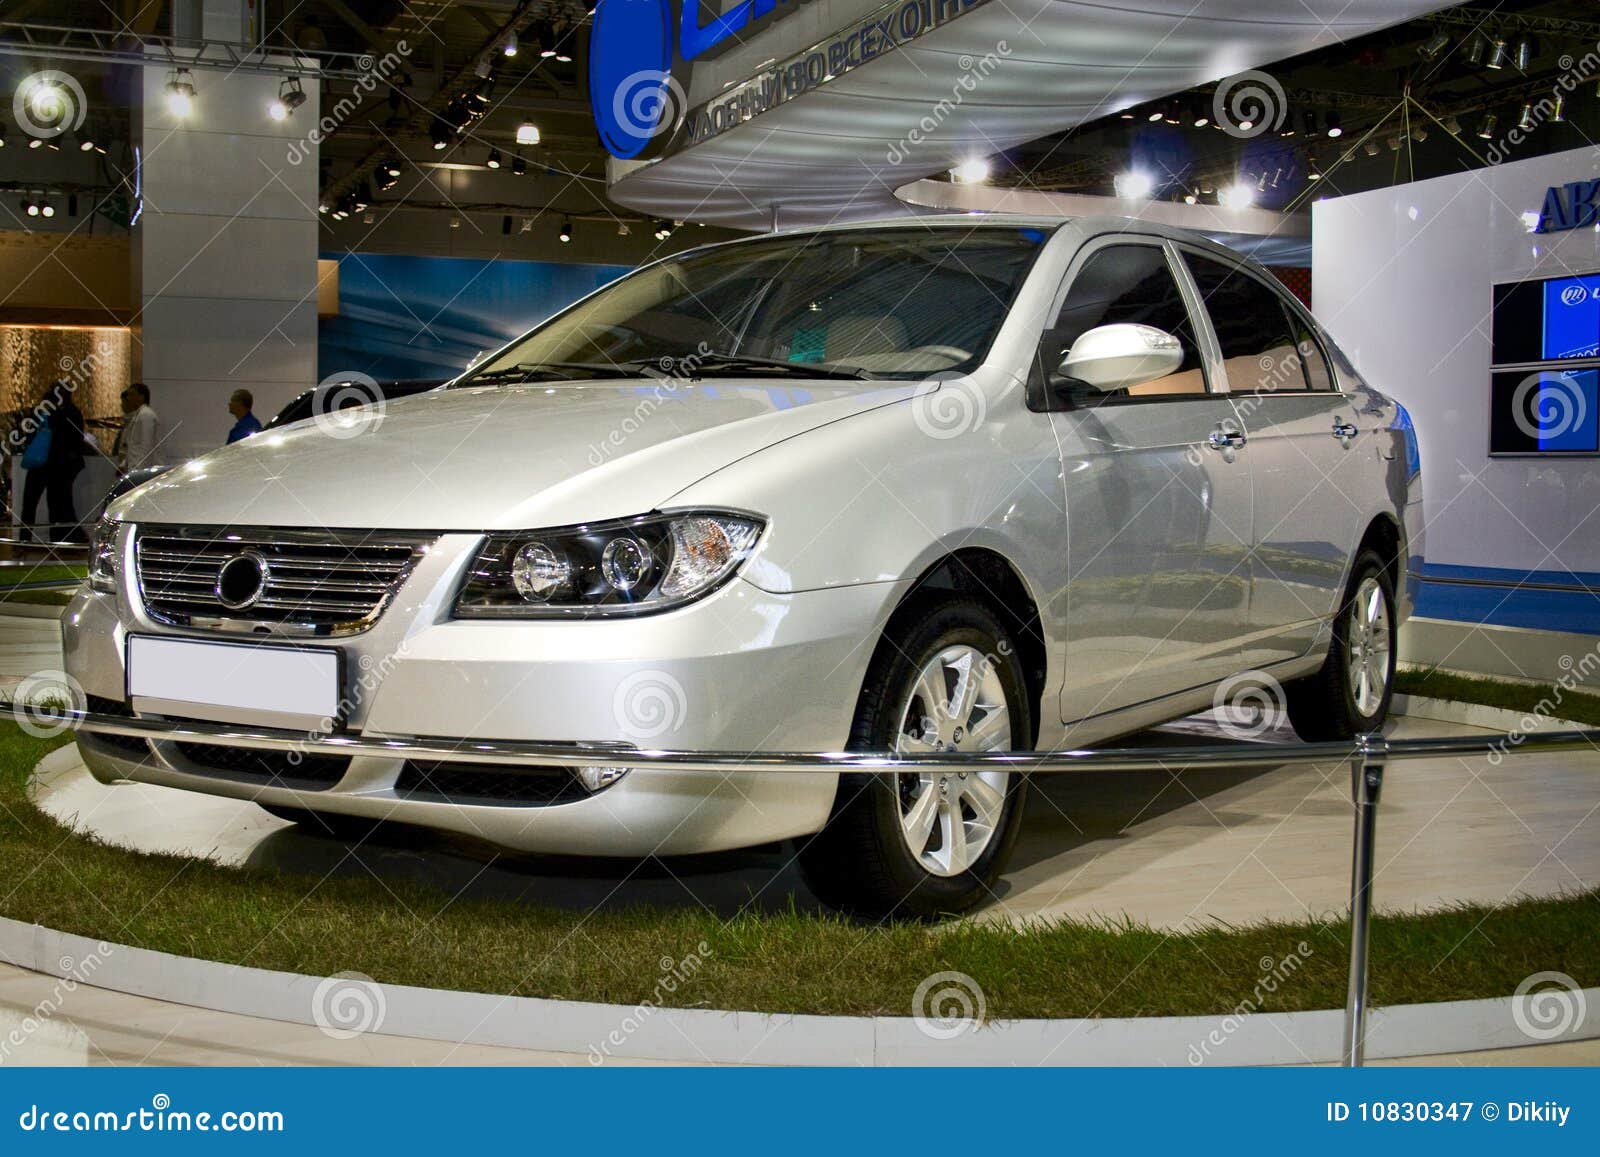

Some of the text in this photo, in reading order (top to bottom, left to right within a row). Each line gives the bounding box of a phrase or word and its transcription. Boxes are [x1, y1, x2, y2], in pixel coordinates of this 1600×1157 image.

[785, 52, 826, 97] ВО
[827, 11, 898, 78] ВСЕХ
[1534, 177, 1600, 235] АВ
